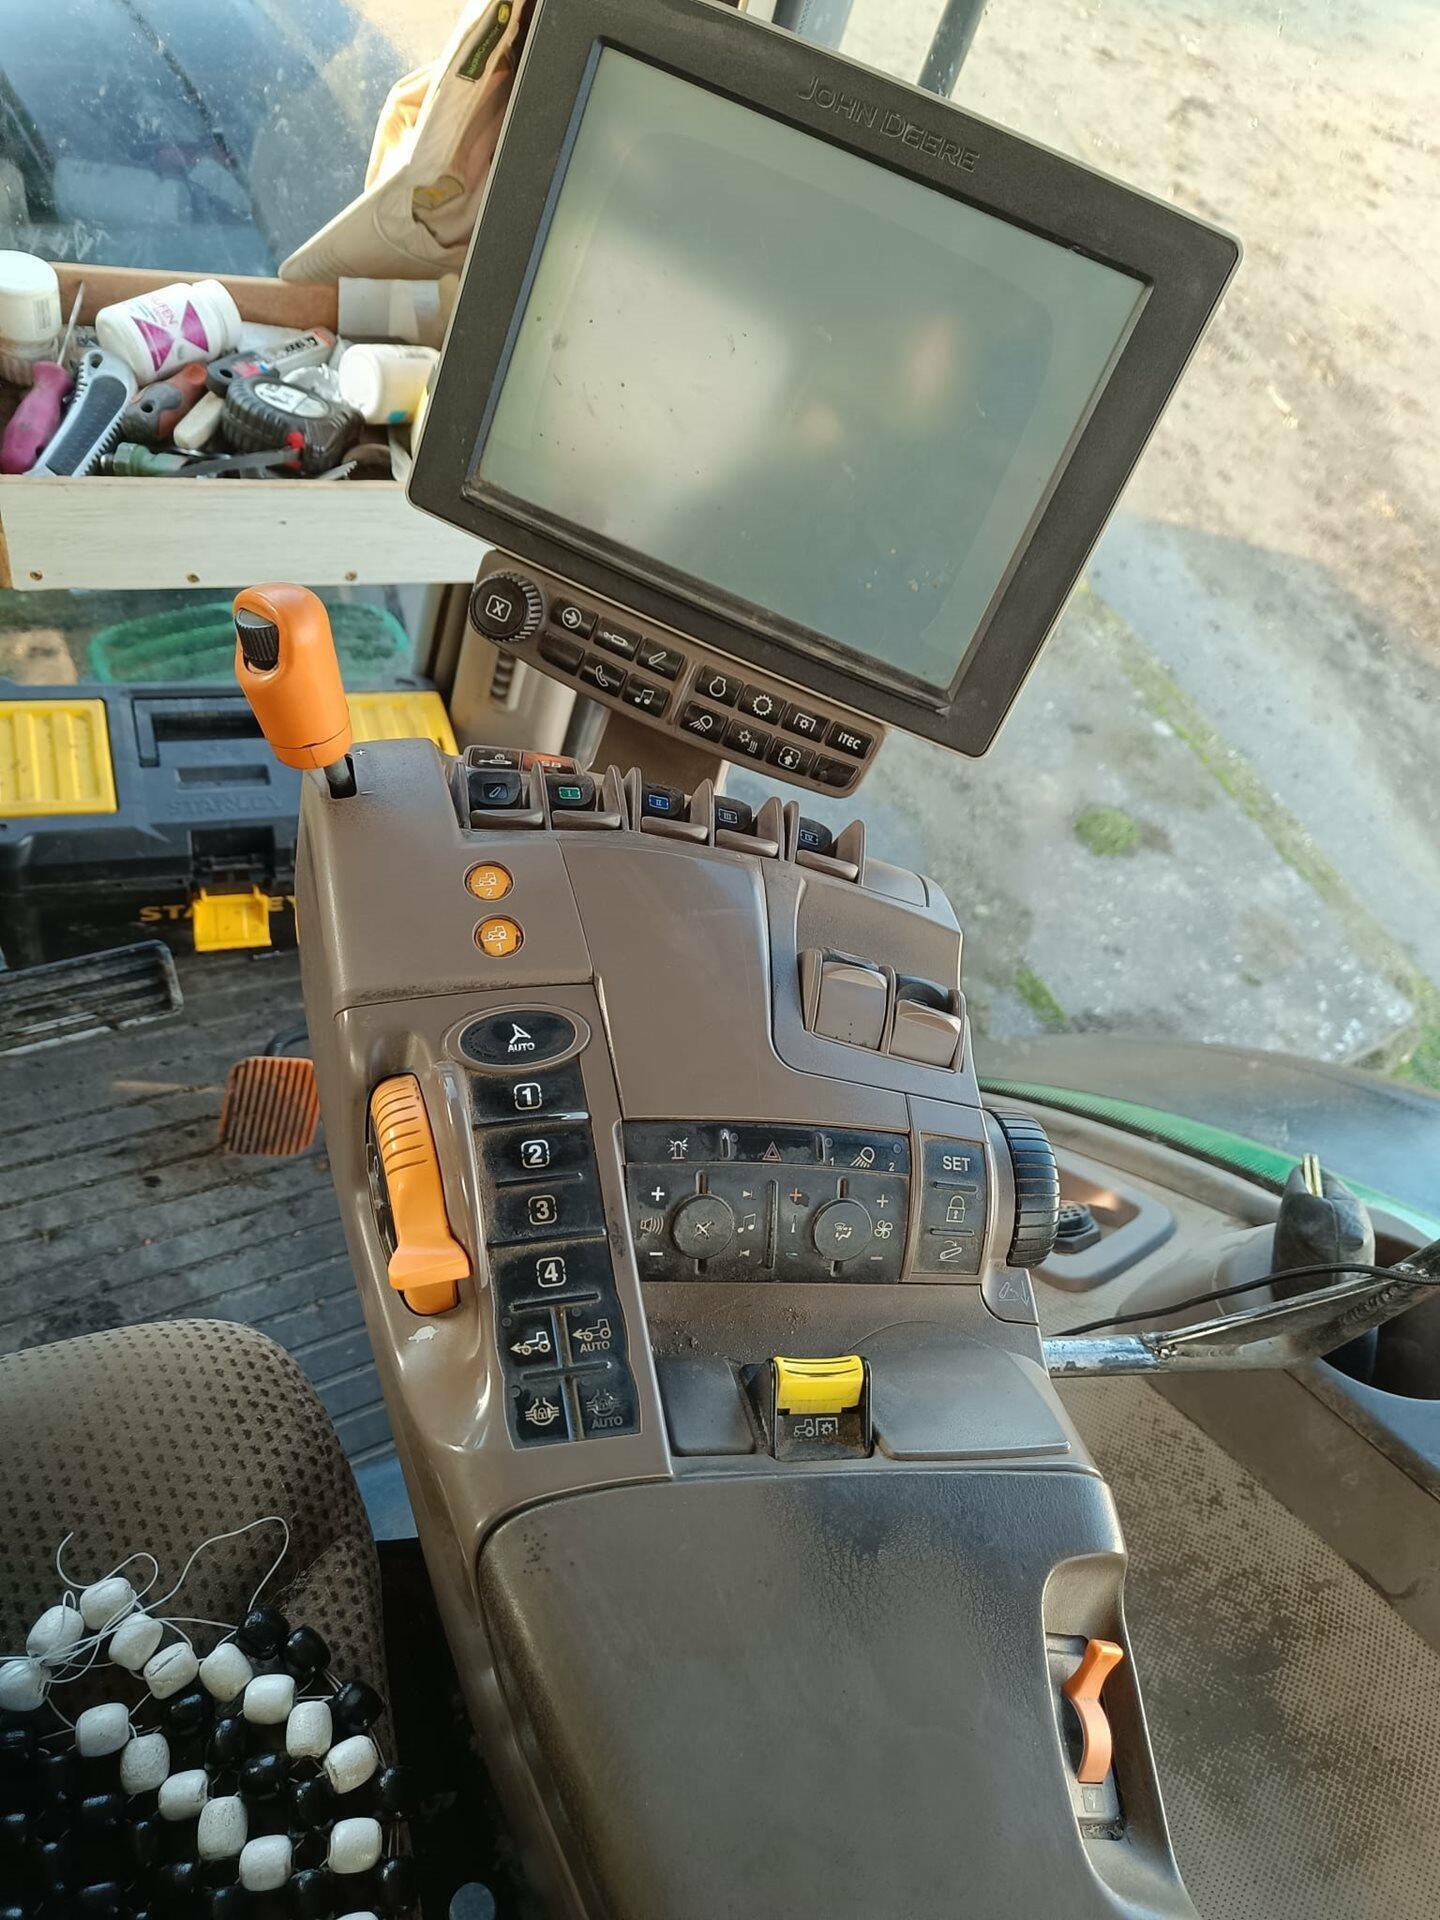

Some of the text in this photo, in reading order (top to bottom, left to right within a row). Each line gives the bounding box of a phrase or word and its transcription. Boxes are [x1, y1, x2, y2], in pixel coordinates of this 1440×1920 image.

[798, 76, 981, 173] JOHN DEERE
[487, 888, 493, 896] 2
[496, 943, 503, 951] 1
[508, 1042, 535, 1053] AUTO
[521, 1087, 532, 1106] 1
[528, 1144, 543, 1164] 2
[829, 1157, 835, 1166] 1
[889, 1162, 895, 1172] 2
[942, 1155, 971, 1172] SET
[536, 1200, 550, 1220] 3
[544, 1262, 558, 1282] 4
[580, 1340, 610, 1353] AUTO
[592, 1416, 623, 1430] AUTO
